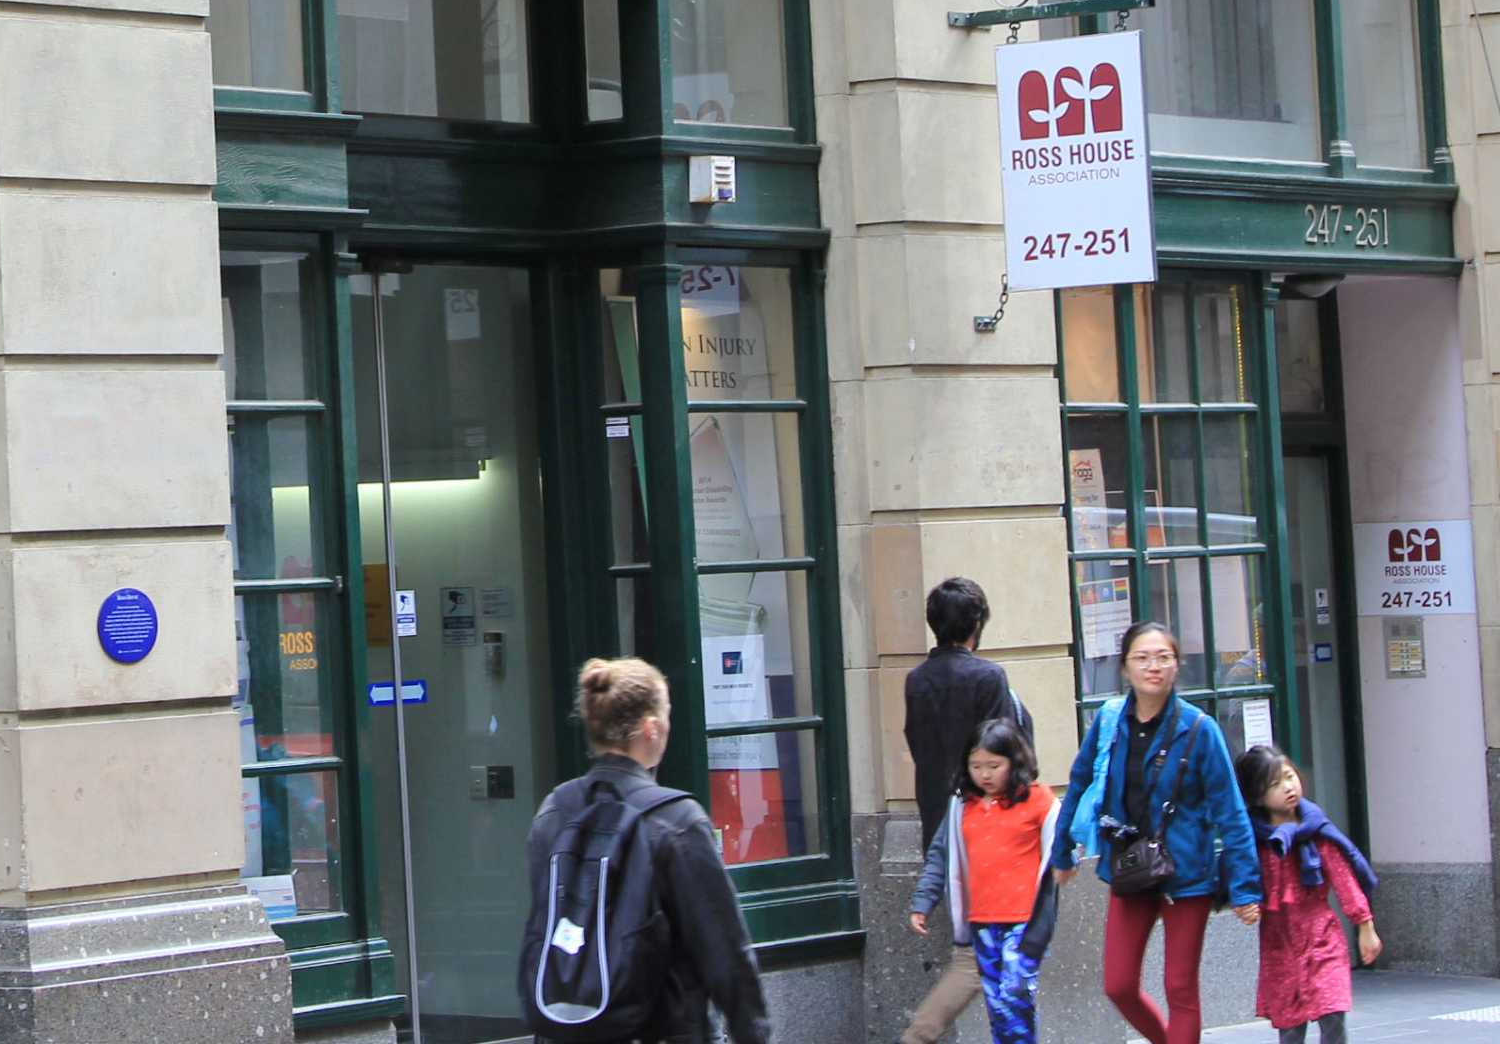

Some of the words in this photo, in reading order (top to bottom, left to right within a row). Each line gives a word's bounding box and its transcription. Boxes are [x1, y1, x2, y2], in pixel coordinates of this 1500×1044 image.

[1011, 145, 1063, 171] ROSS
[1068, 138, 1135, 165] HOUSE
[1027, 166, 1121, 187] ASSOCIATION
[1304, 203, 1390, 247] 247-251
[1022, 226, 1130, 261] 247-251
[698, 333, 757, 357] INJURY
[1384, 565, 1411, 577] ROSS
[1414, 564, 1447, 576] HOUSE
[1381, 591, 1452, 608] 247-251
